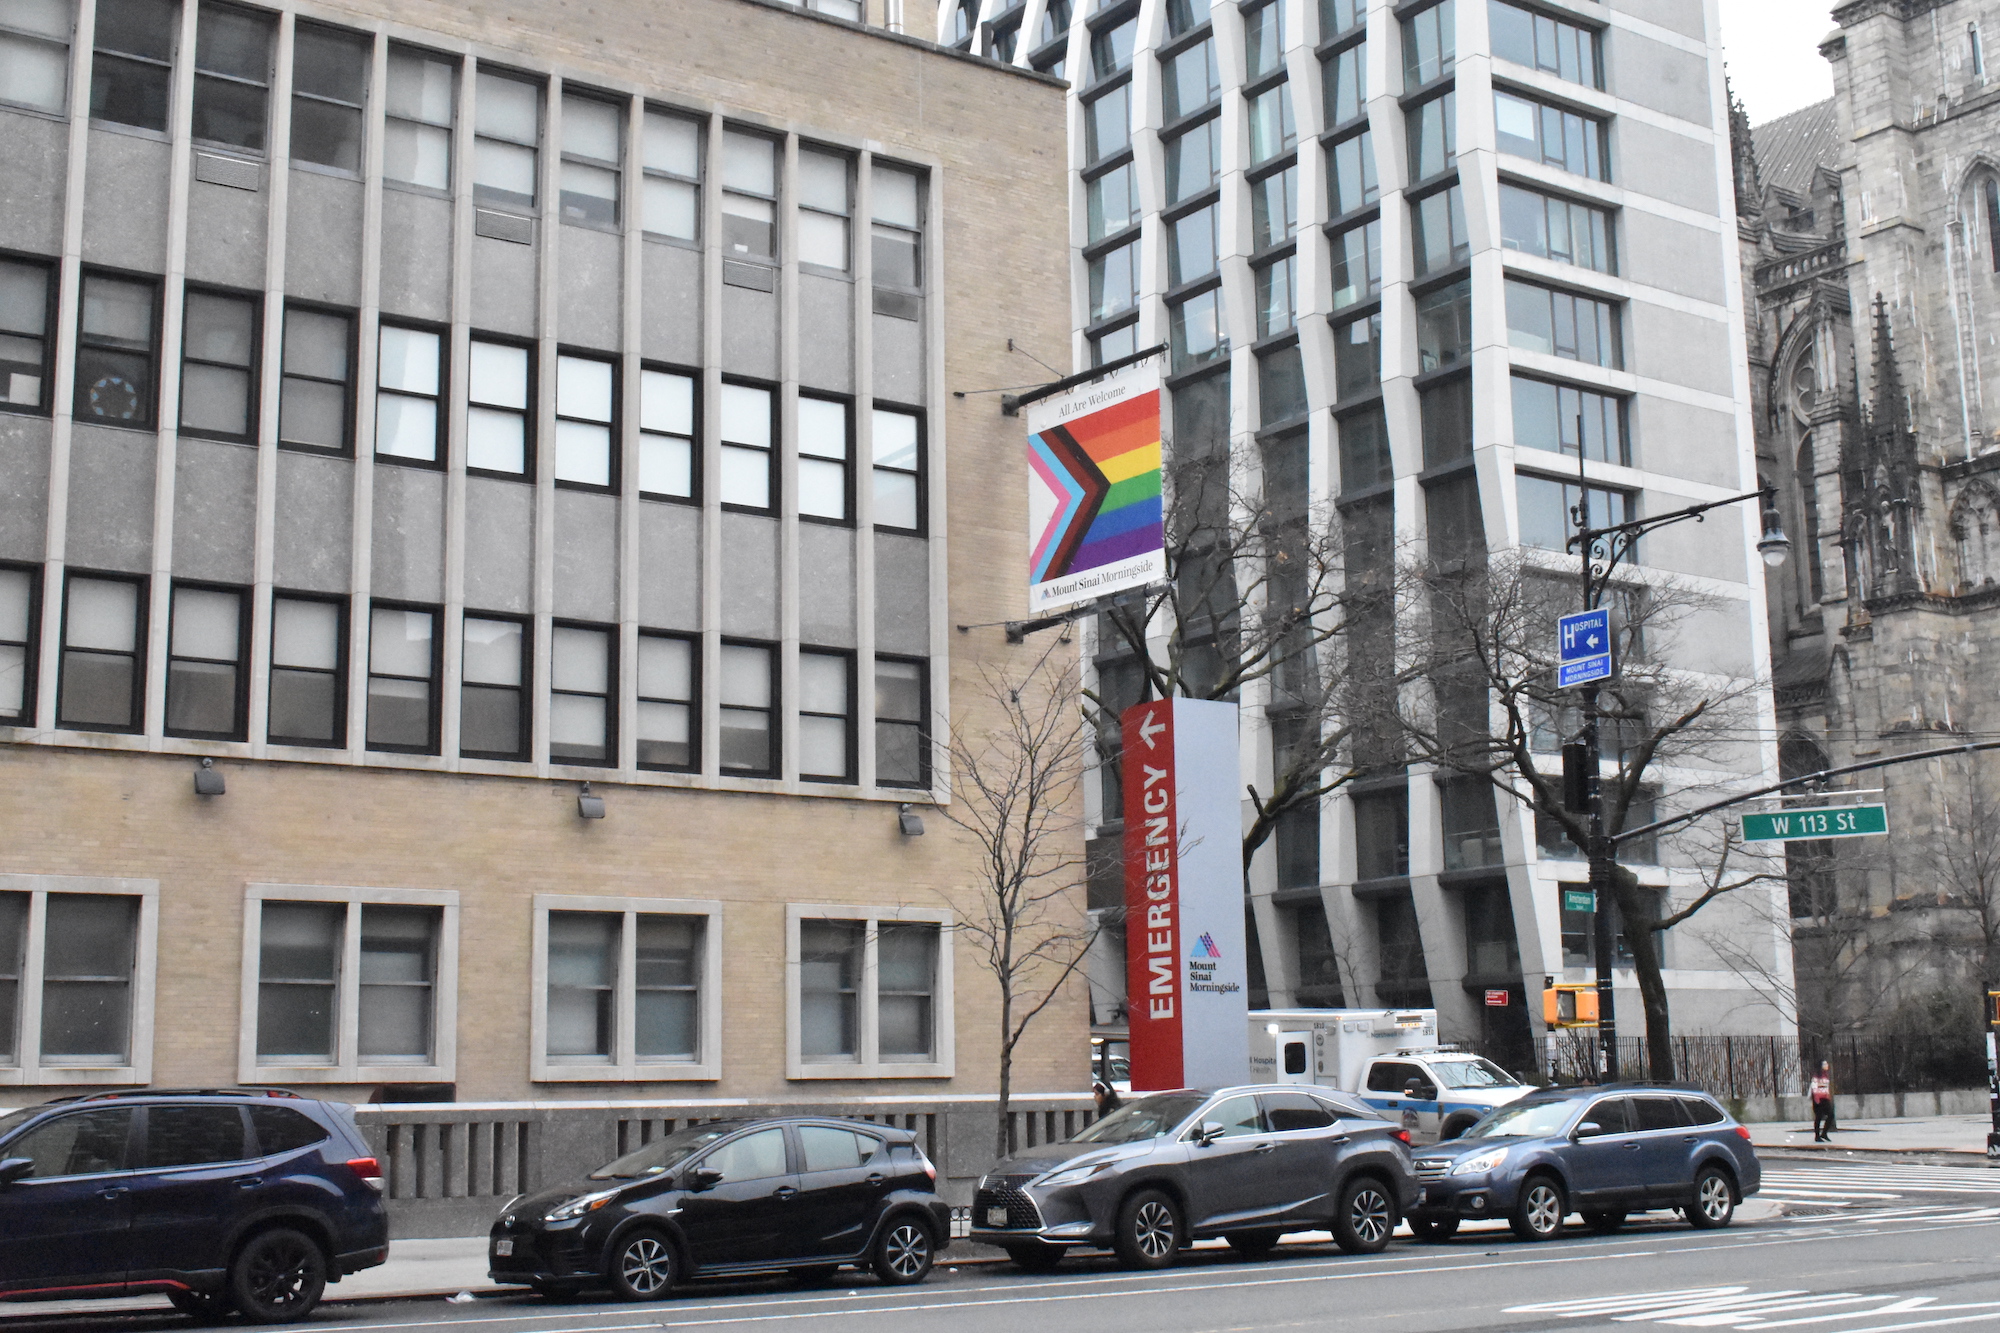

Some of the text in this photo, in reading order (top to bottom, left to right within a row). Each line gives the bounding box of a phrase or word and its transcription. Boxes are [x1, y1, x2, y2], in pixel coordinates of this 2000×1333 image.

[1059, 386, 1126, 418] All Are Welcome
[1052, 560, 1153, 597] Mount Sinai Morningside
[1566, 659, 1603, 674] MOUNT SINAI
[1565, 668, 1604, 683] MORNINGSIDE
[1772, 812, 1857, 835] W 113 St
[1143, 764, 1174, 1020] EMERGENCY
[1190, 961, 1217, 971] Mount
[1190, 971, 1212, 981] Sinai
[1190, 982, 1240, 995] Morningside
[1253, 1056, 1277, 1065] Hospita
